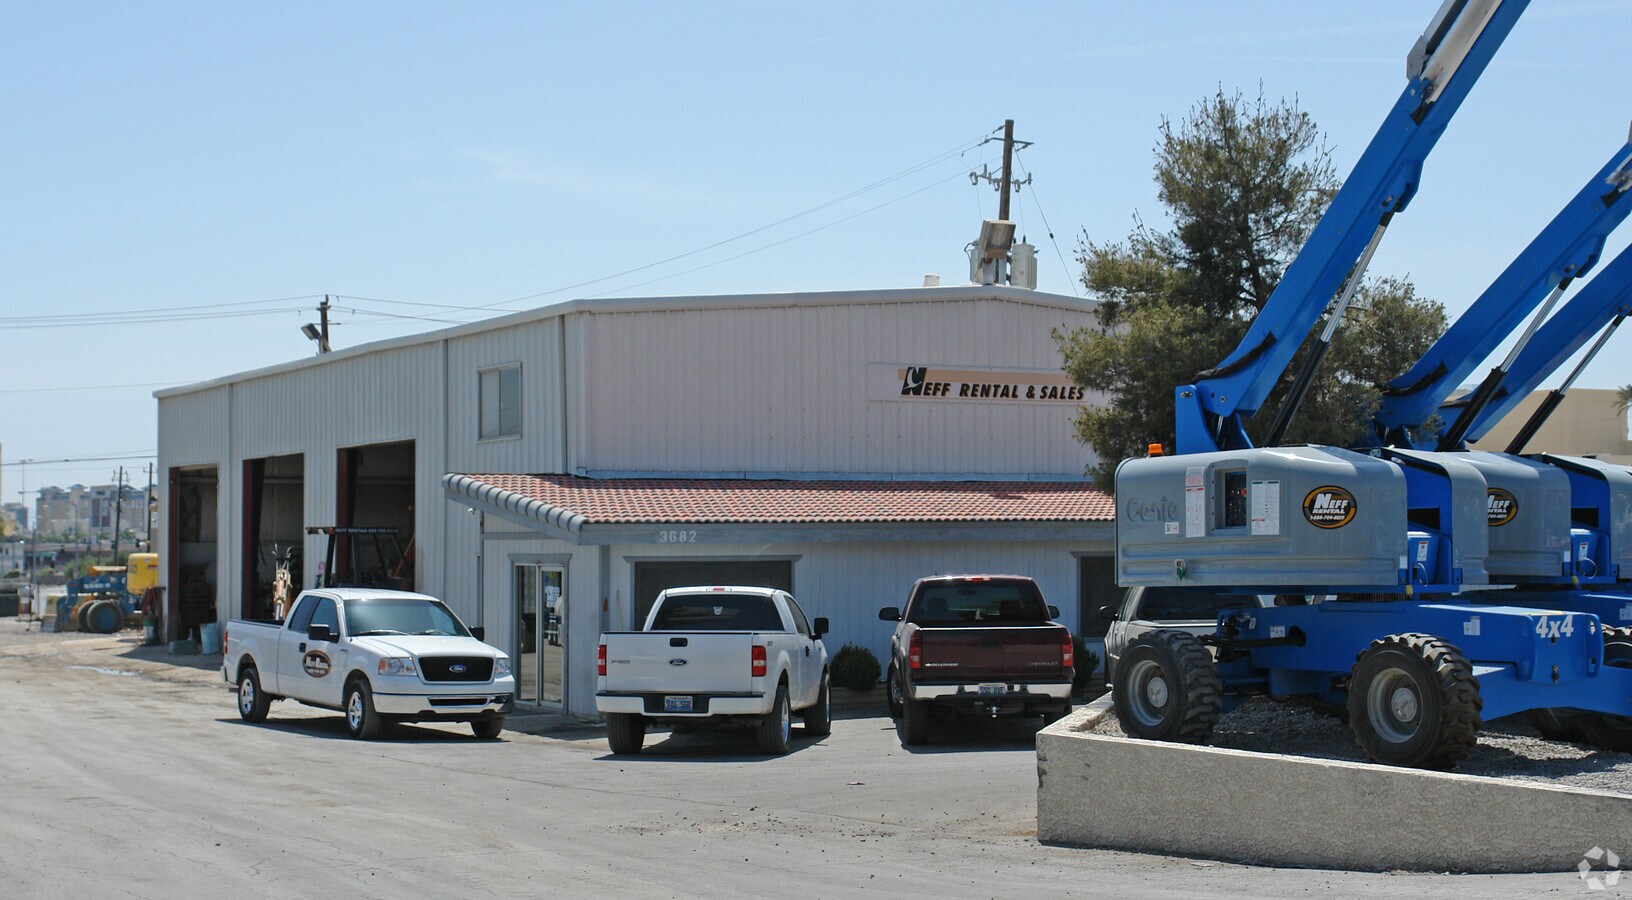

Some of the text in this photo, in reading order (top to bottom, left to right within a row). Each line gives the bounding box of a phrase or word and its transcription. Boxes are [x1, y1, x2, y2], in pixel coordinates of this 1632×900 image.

[901, 367, 1085, 400] NEFF RENTAL & SALES
[1127, 496, 1179, 522] Genie
[1314, 493, 1349, 509] NEFF
[660, 530, 697, 543] 3682
[1536, 615, 1575, 639] 4x4
